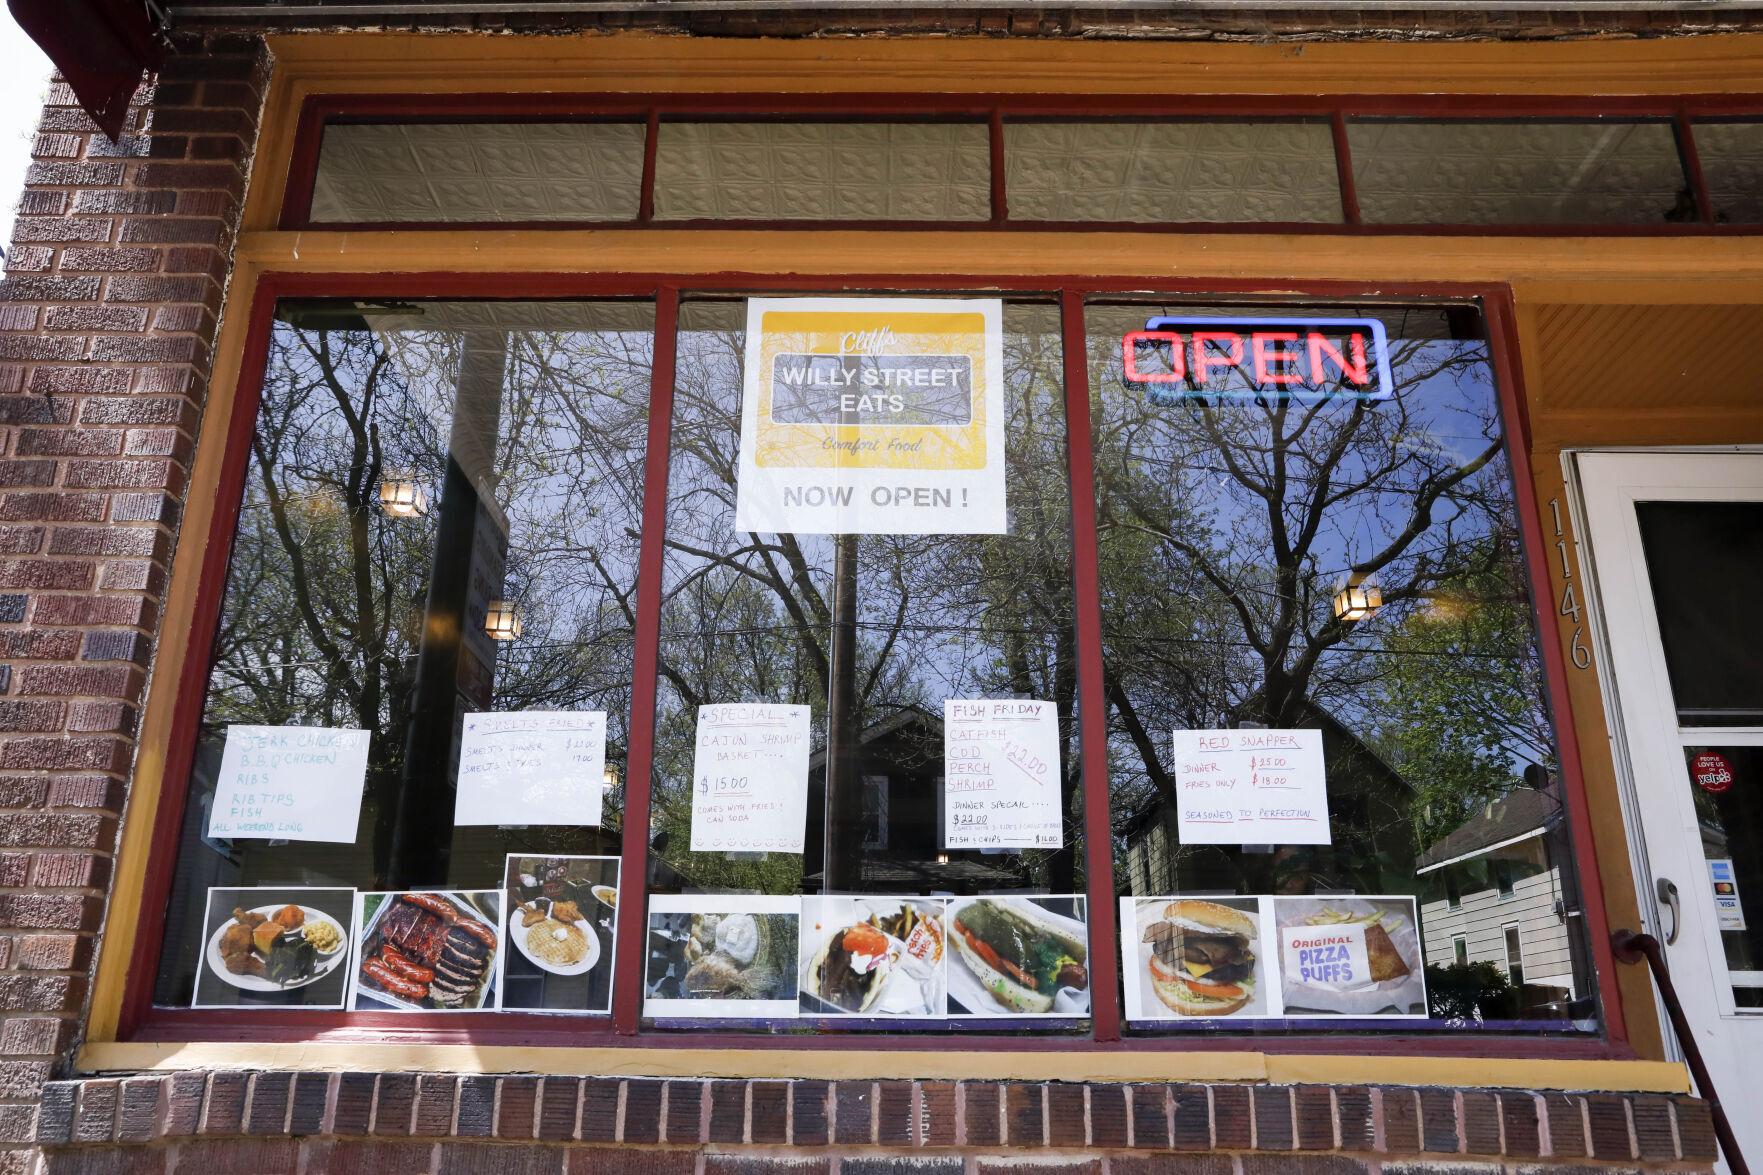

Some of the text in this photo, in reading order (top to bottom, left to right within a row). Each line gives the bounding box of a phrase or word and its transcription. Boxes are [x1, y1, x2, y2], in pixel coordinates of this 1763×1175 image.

[841, 325, 897, 354] Cliff's
[1121, 331, 1368, 385] OPEN
[782, 367, 963, 387] WILLY STREET
[840, 394, 904, 412] EATS
[822, 437, 923, 456] Comfort Food
[782, 486, 854, 507] NOW
[870, 486, 952, 508] OPEN
[1550, 498, 1591, 669] 1146
[707, 707, 785, 723] SPECIAL
[953, 704, 985, 718] FISH
[701, 733, 747, 747] CAJUN
[949, 728, 1006, 740] CATFISH
[241, 735, 288, 753] JERK
[1199, 734, 1299, 749] RED SNAPPER
[284, 751, 337, 765] CHICKEN
[949, 745, 981, 758] COD
[950, 761, 992, 772] PERCH
[1182, 762, 1222, 774] DINNER
[236, 772, 270, 785] RIBS
[947, 778, 995, 791] SHRIMP
[1184, 780, 1211, 790] FRIES
[1216, 778, 1237, 790] ONLY
[1698, 773, 1720, 785] yelp
[231, 792, 294, 807] RIB TIPS
[952, 801, 985, 810] DINNER
[231, 807, 262, 817] FISH
[1184, 808, 1311, 820] SEASONED TO PERFECTION
[212, 823, 230, 832] ALL
[278, 823, 304, 833] LONG
[1291, 936, 1353, 949] ORIGINAL
[1300, 945, 1351, 966] PIZZA
[1300, 962, 1353, 983] PUFFS
